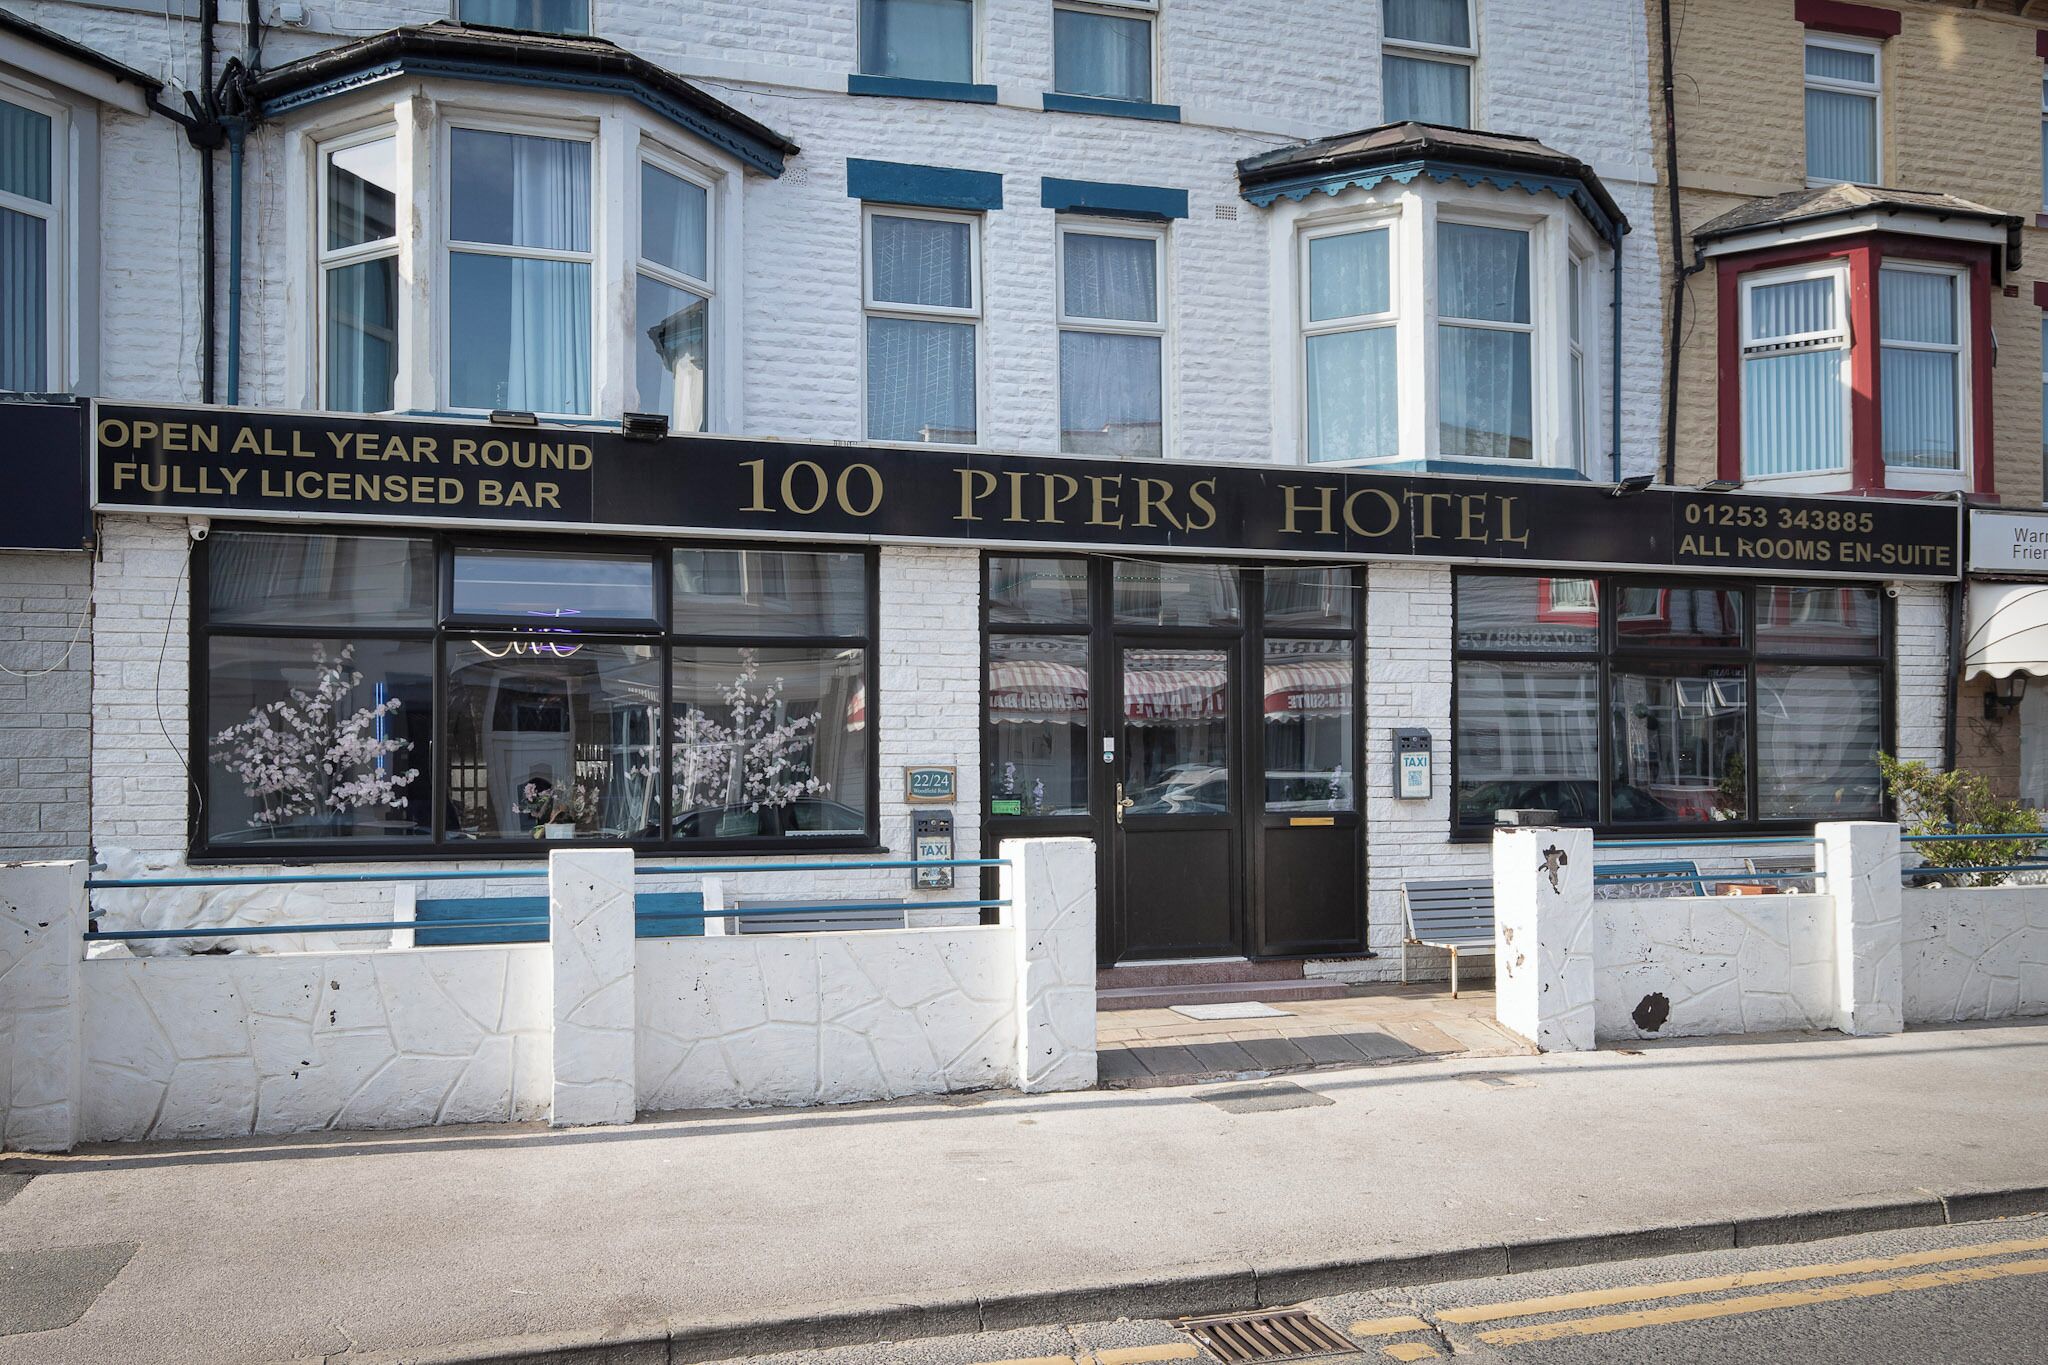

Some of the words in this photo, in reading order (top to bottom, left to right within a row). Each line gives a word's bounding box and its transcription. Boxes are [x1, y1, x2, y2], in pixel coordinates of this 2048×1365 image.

[98, 419, 219, 453] OPEN
[230, 427, 316, 458] ALL
[326, 431, 440, 464] YEAR
[452, 438, 593, 471] ROUND
[113, 462, 249, 496] FULLY
[261, 469, 465, 505] LICENSED
[478, 479, 561, 509] BAR
[737, 458, 884, 518] 100
[952, 468, 1218, 534] PIPERS
[1277, 484, 1530, 550] HOTEL
[1685, 503, 1768, 528] 01253
[1777, 507, 1874, 533] 343885
[2014, 527, 2048, 543] War
[1678, 534, 1730, 557] ALL
[1737, 537, 1831, 561] ROOMS
[1839, 541, 1951, 567] EN-SUITE
[1404, 757, 1427, 767] TAXI
[913, 774, 950, 787] 22/24
[920, 845, 948, 856] TAXI
